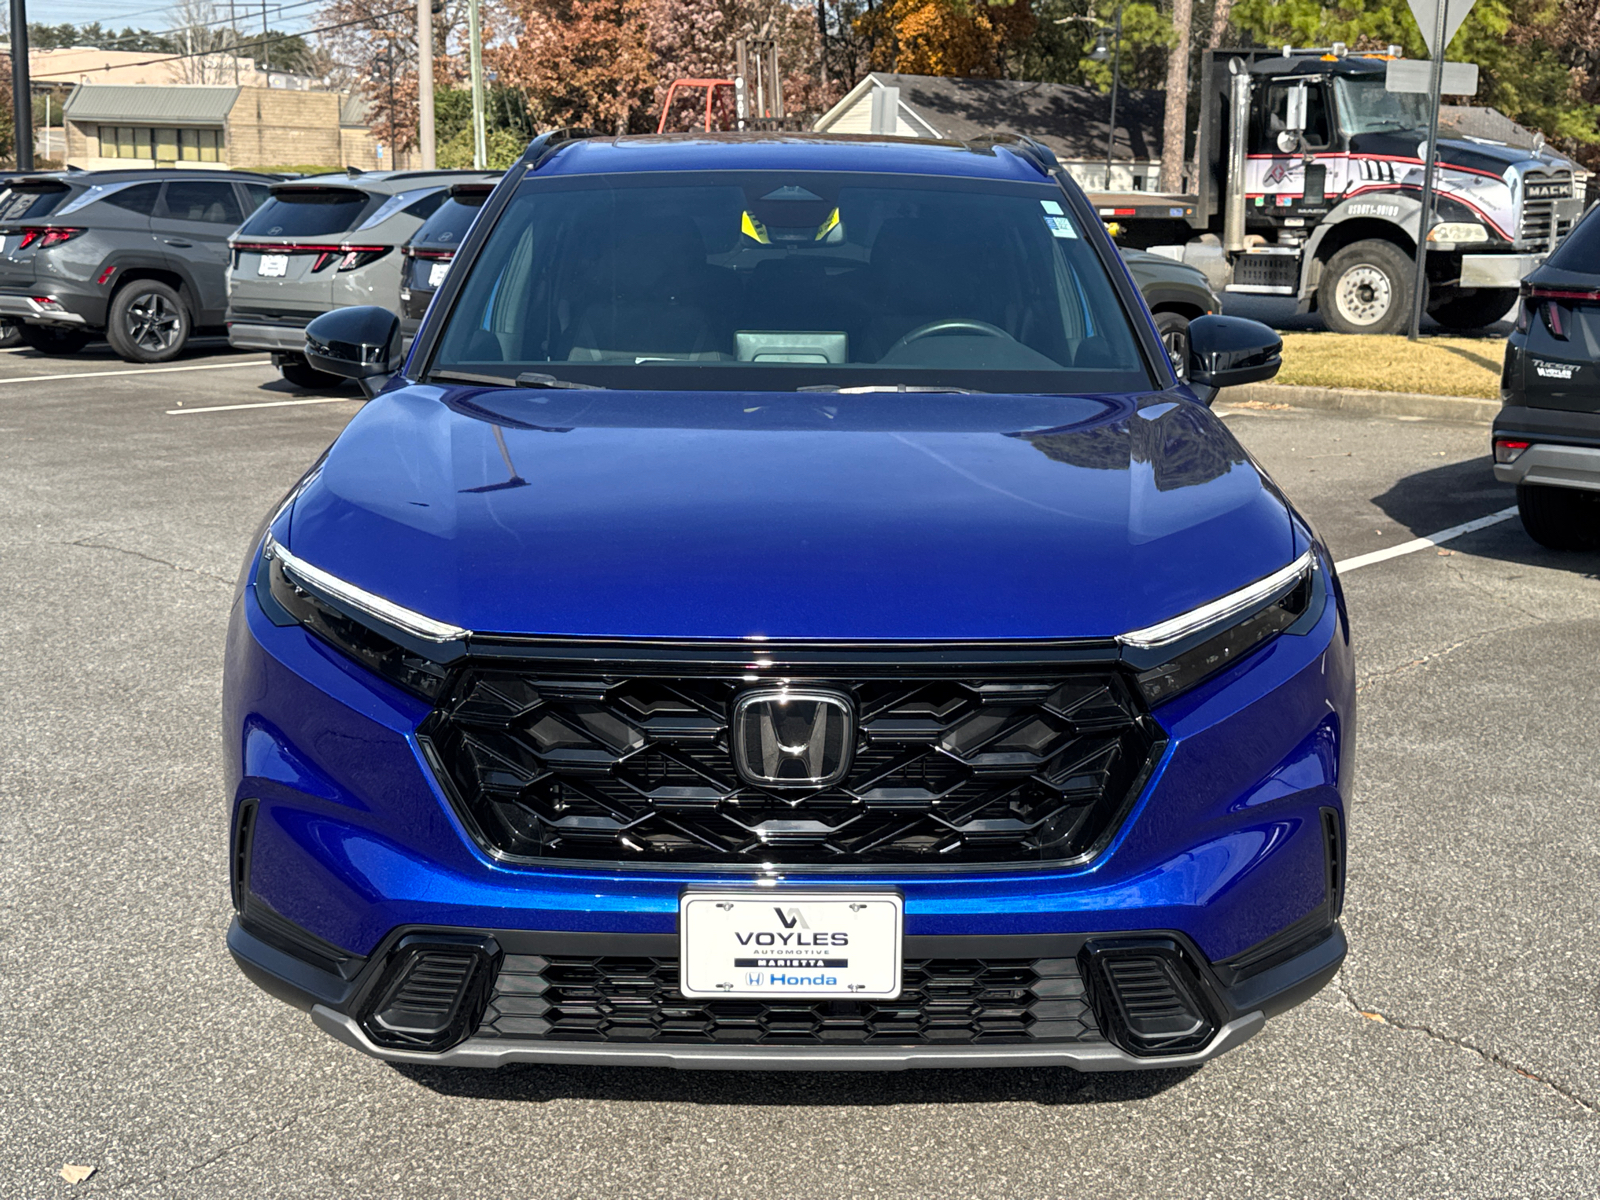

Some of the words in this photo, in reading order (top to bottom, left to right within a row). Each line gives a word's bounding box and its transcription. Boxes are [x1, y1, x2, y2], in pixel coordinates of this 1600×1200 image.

[1529, 186, 1569, 196] MACK
[734, 932, 849, 946] VOYLES
[757, 959, 825, 967] MARIETTA
[770, 974, 837, 986] Honda
